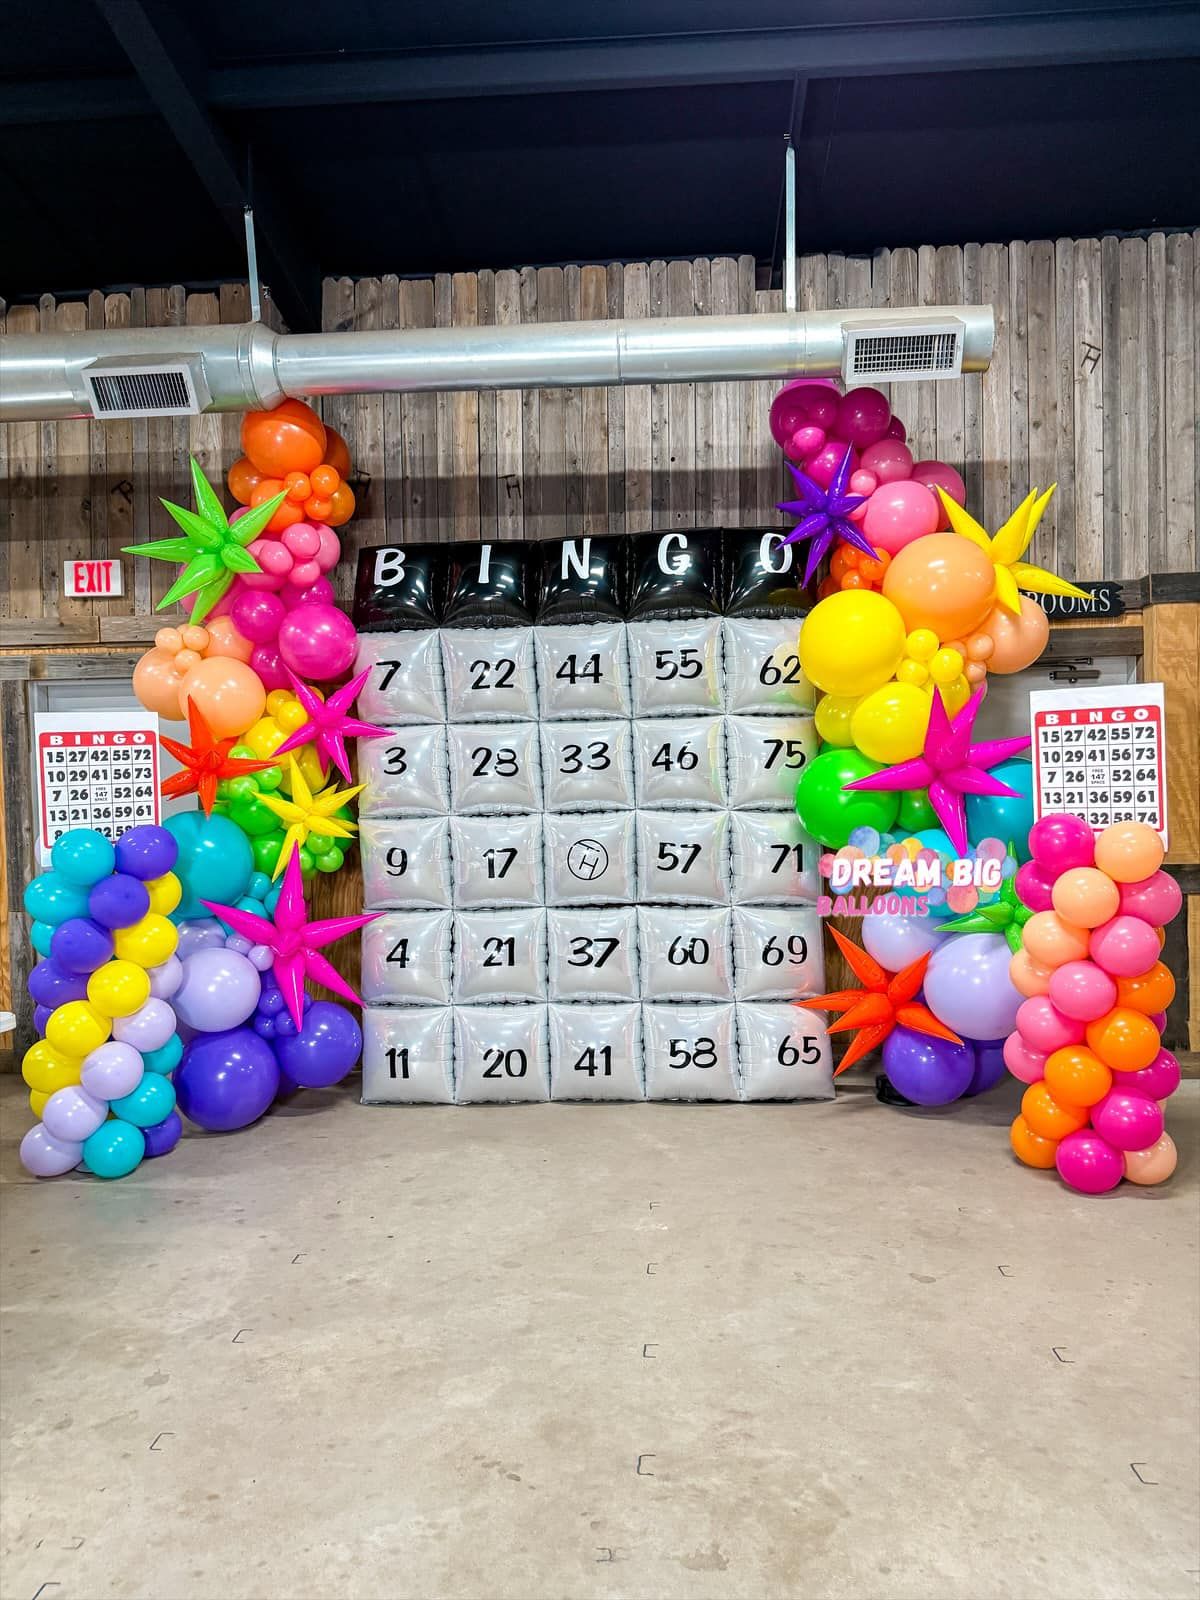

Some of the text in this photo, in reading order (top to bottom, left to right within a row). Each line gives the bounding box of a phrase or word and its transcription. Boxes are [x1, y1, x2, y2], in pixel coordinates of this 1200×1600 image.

[73, 561, 113, 593] EXIT
[376, 648, 801, 690] 7 22 44 55 62
[1042, 726, 1155, 743] 15 27 42 55 72
[47, 749, 152, 763] 15 27 42 55 72
[383, 739, 806, 777] 3 28 33 46 75
[1043, 748, 1156, 763] 10 29 41 56 73
[48, 768, 152, 782] 10 29 41 56 73
[1047, 771, 1057, 783] 7
[1065, 771, 1085, 783] 26
[1112, 769, 1132, 782] 52
[1135, 769, 1156, 781] 64
[52, 790, 62, 801] 7
[70, 789, 89, 800] 26
[114, 787, 132, 799] 52
[135, 786, 153, 798] 64
[1044, 790, 1155, 804] 13 21 36 59 61
[50, 805, 152, 821] 13 21 36 59 61
[1090, 812, 1109, 824] 32
[1113, 812, 1133, 823] 58
[1137, 812, 1158, 824] 74
[386, 847, 408, 877] 9
[483, 847, 518, 879] 17
[656, 842, 702, 874] 57
[770, 844, 803, 873] 71
[386, 935, 808, 969] 4 21 37 60 69
[385, 1035, 821, 1079] 11 20 41 58 65
